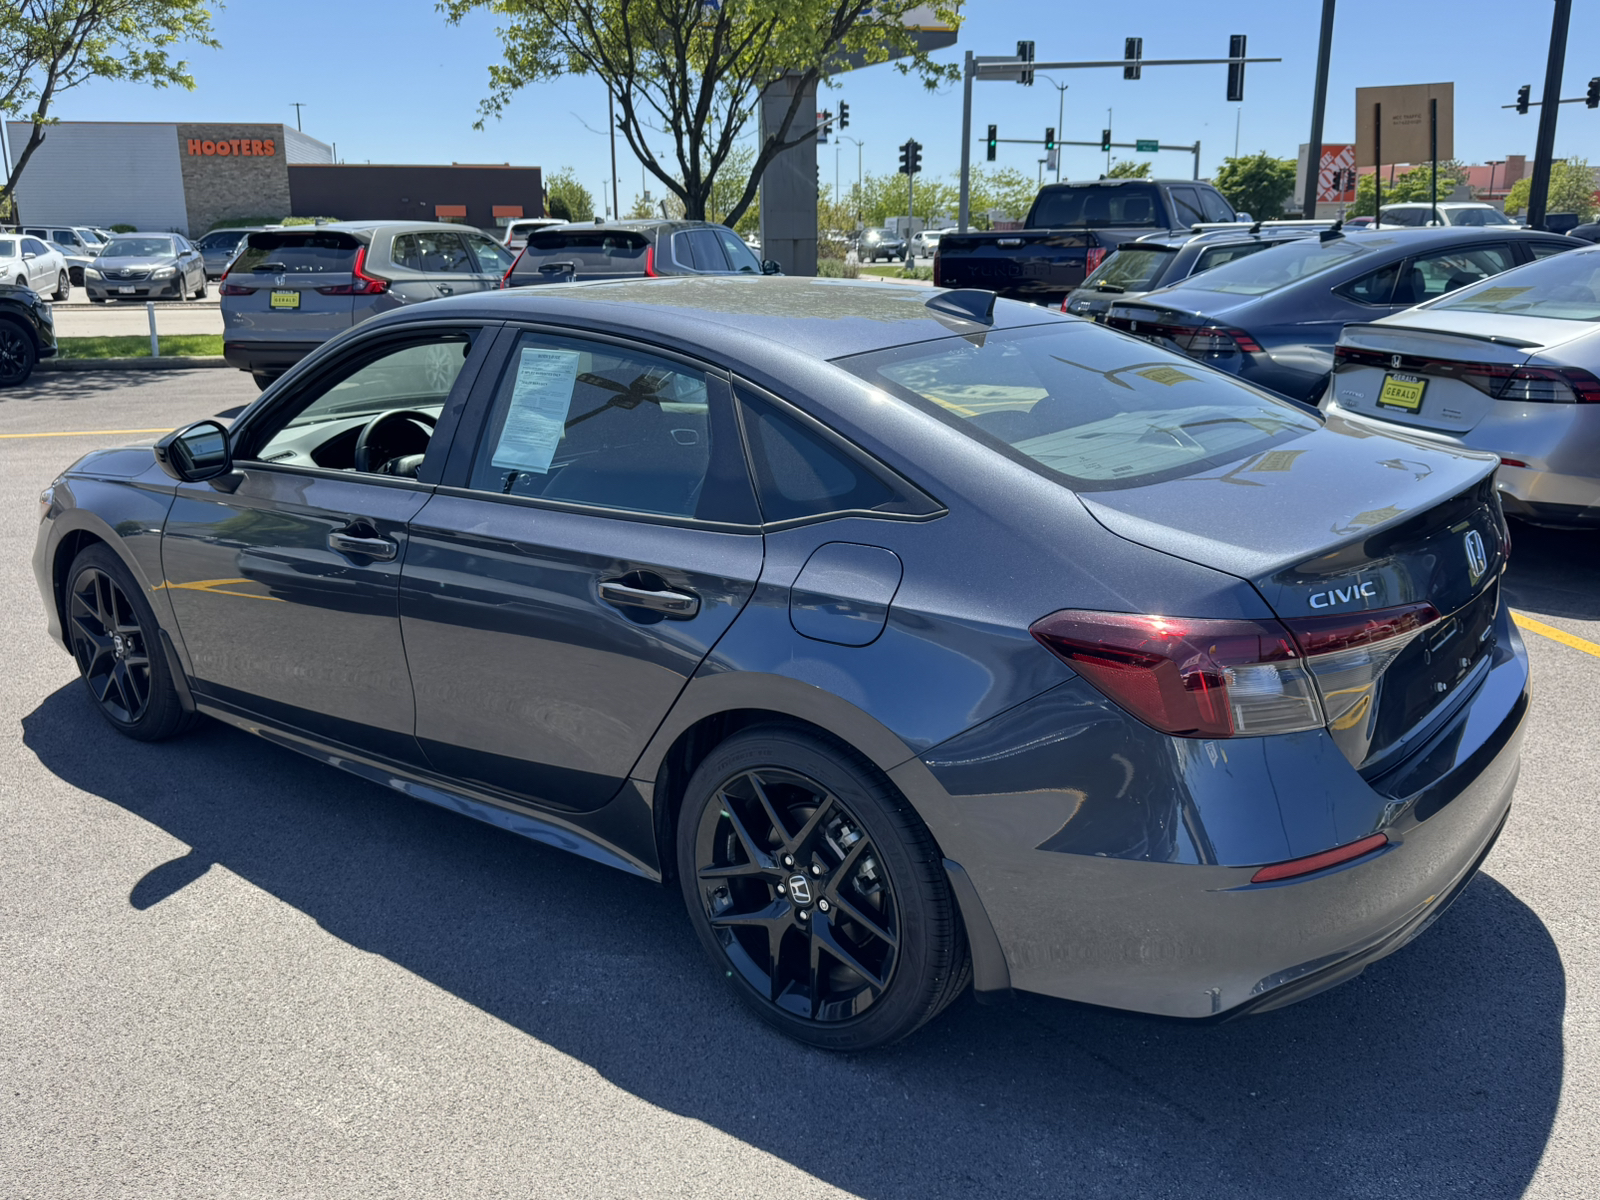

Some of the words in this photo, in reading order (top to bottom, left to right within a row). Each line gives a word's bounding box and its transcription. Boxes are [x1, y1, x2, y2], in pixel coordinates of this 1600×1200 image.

[187, 139, 276, 156] HOOTERS
[1392, 373, 1418, 383] GERALD
[1386, 386, 1417, 400] GERALD
[1309, 580, 1377, 609] CIVIC
